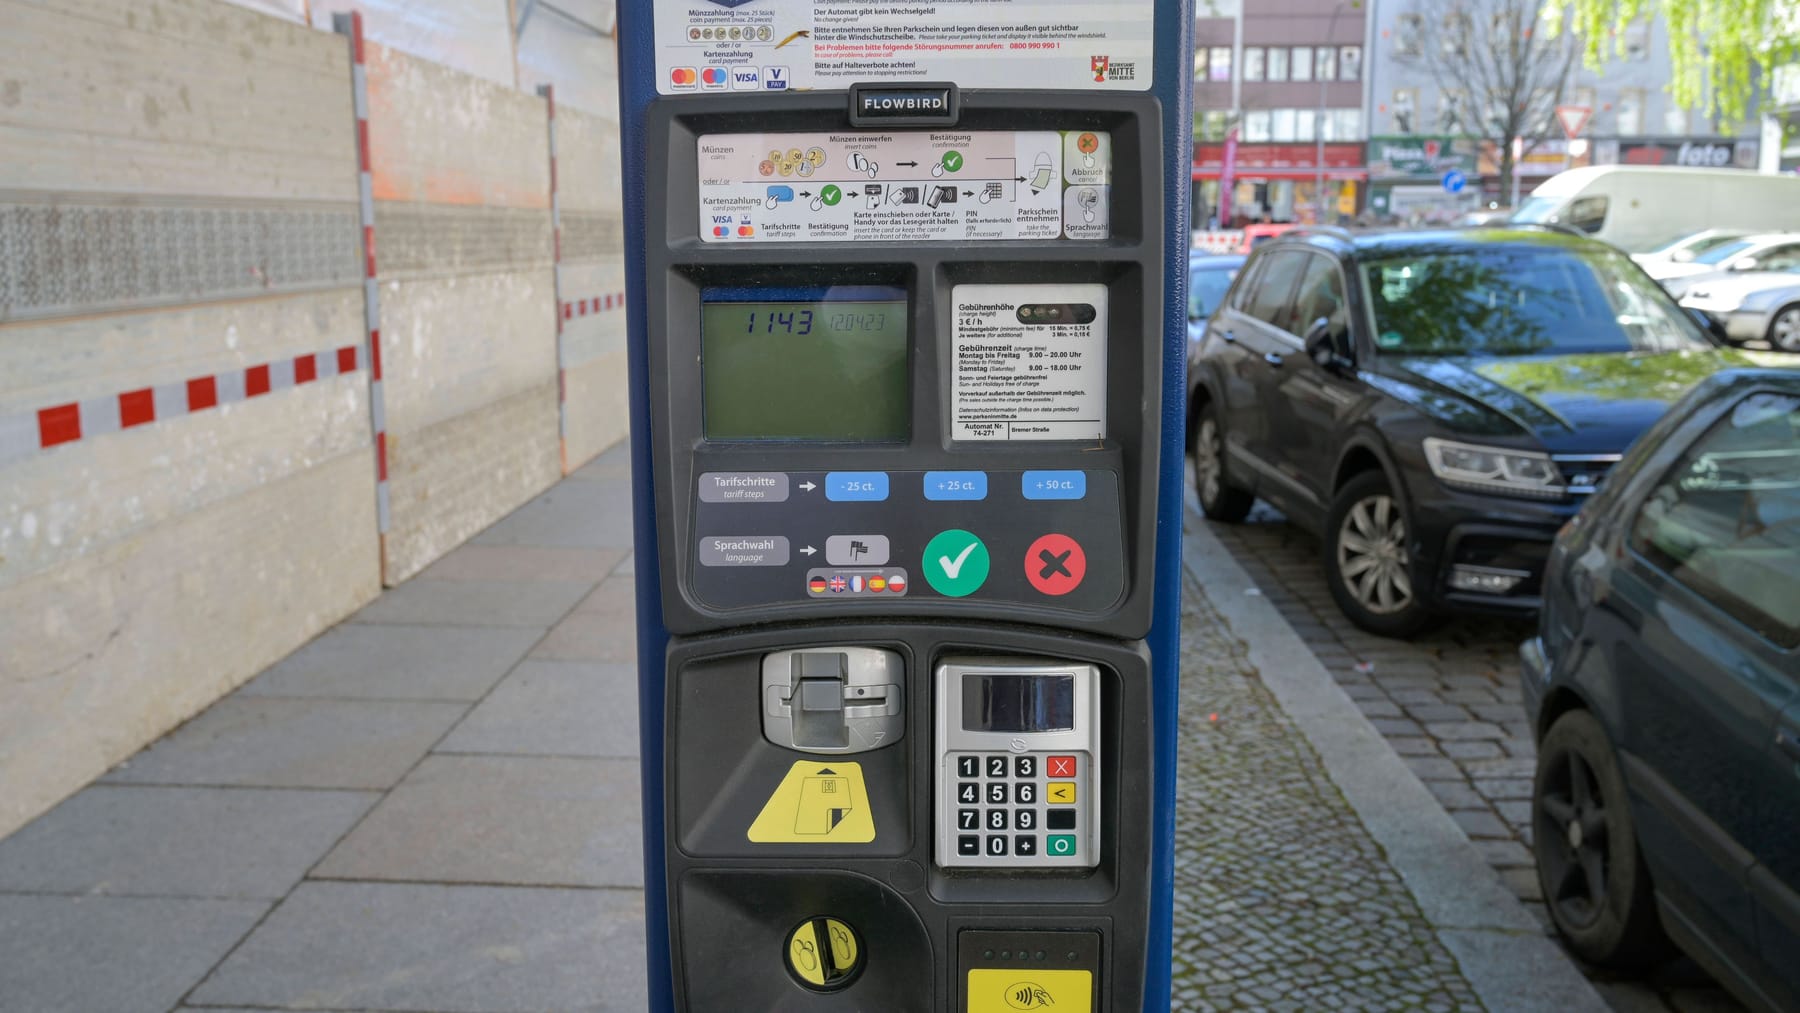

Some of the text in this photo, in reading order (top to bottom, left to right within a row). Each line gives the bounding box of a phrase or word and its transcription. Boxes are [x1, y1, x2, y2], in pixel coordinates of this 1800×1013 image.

[688, 10, 734, 18] Münzzahlung
[890, 8, 936, 16] Wechselgeld!
[734, 73, 757, 82] VISA
[771, 69, 781, 79] V
[864, 98, 942, 110] FLOWBIRD
[930, 134, 971, 142] Bestätigung
[1678, 142, 1730, 166] foto
[703, 198, 761, 206] Kartenzahlung
[903, 218, 935, 226] Lesegerät
[748, 310, 885, 335] 1143 120423
[714, 477, 776, 487] Tarifschritte
[847, 482, 859, 491] 25
[862, 482, 875, 491] ct.
[948, 481, 960, 490] 25
[963, 481, 975, 490] ct.
[1046, 480, 1058, 489] 50
[1062, 480, 1074, 489] ct.
[724, 490, 764, 499] tariff steps
[714, 540, 774, 551] Sprachwahl
[726, 554, 764, 563] language
[964, 760, 972, 774] 1
[992, 760, 1003, 774] 2
[1021, 759, 1031, 774] 3
[962, 786, 974, 801] 4
[992, 786, 1003, 801] 5
[1021, 786, 1031, 801] 6
[962, 812, 974, 827] 7
[992, 812, 1003, 828] 8
[1020, 812, 1031, 828] 9
[992, 838, 1002, 853] 0
